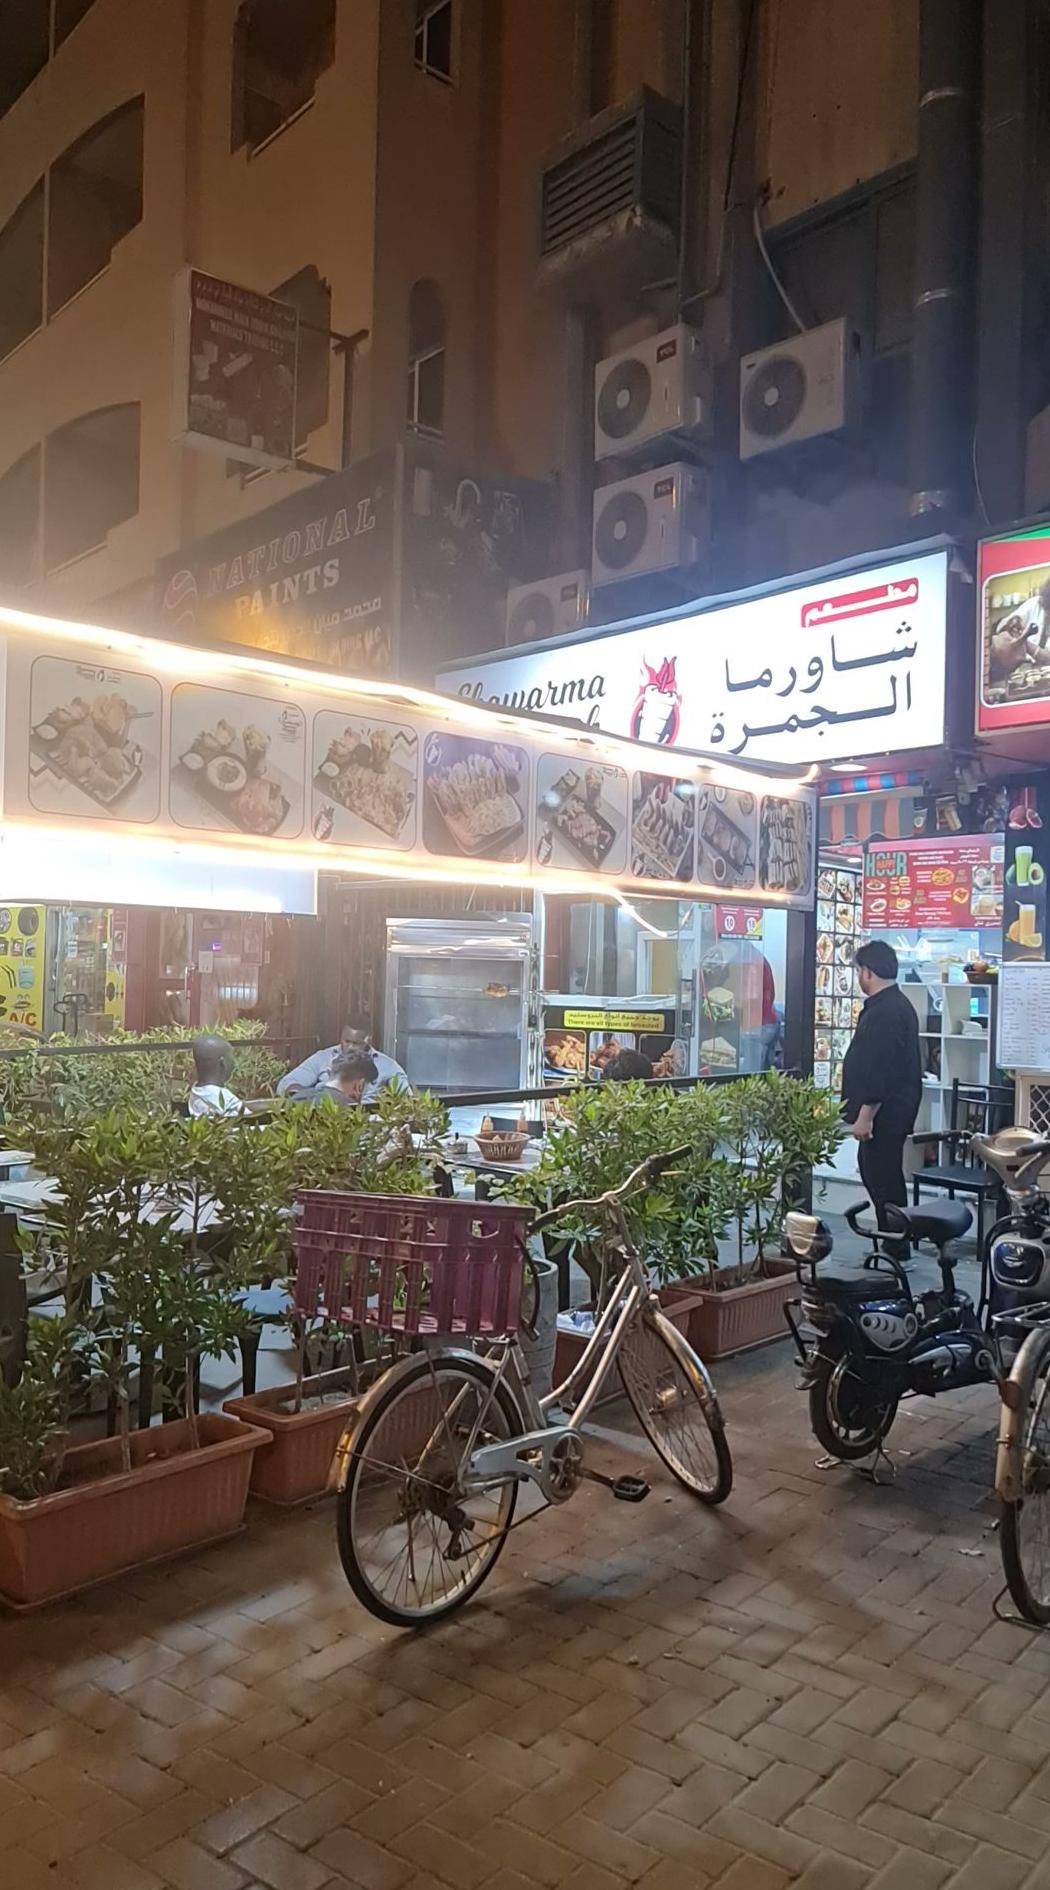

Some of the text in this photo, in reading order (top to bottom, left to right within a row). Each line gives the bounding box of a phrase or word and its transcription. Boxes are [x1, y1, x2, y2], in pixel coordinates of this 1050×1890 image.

[206, 497, 376, 597] NATIONAL
[235, 558, 341, 618] PAINTS
[804, 583, 917, 627] مطعم
[725, 620, 918, 698] شاورما
[710, 670, 912, 756] الجمرة
[865, 851, 908, 878] HOUR
